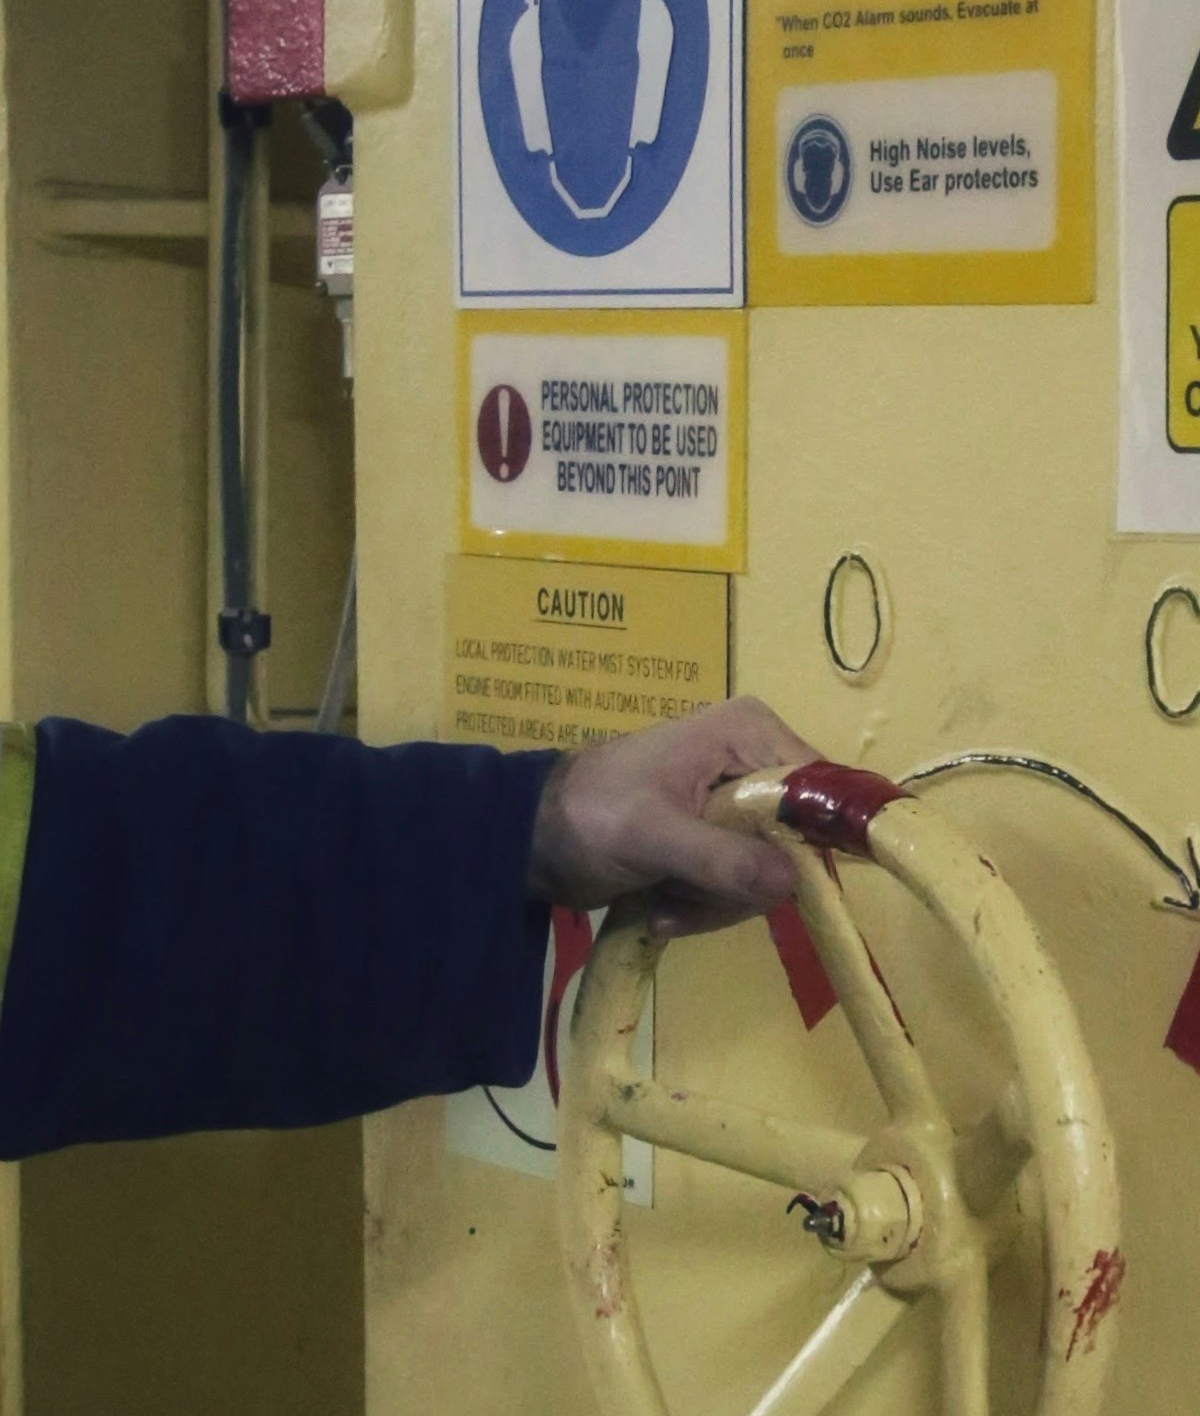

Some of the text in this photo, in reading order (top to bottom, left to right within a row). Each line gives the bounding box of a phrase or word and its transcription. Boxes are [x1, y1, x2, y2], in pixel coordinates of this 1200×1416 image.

[823, 10, 852, 30] CO2
[855, 7, 895, 28] Alarm
[783, 43, 815, 60] once
[870, 133, 1032, 168] High Noise levels,
[870, 166, 1039, 196] Use Ear protectors
[541, 379, 719, 415] PERSONAL PROTECTION
[542, 420, 718, 458] EQUIPMENT TO BE USED
[557, 461, 701, 498] BEYOND THIS POINT
[537, 586, 625, 622] CAUTION
[455, 638, 699, 682] LOCAL PROTECTION WATER MIST SYSTEM FOR
[525, 681, 562, 705] FITTED
[565, 687, 592, 709] WITH
[594, 691, 658, 717] AUTOMATIC
[456, 710, 516, 737] PROTECTED
